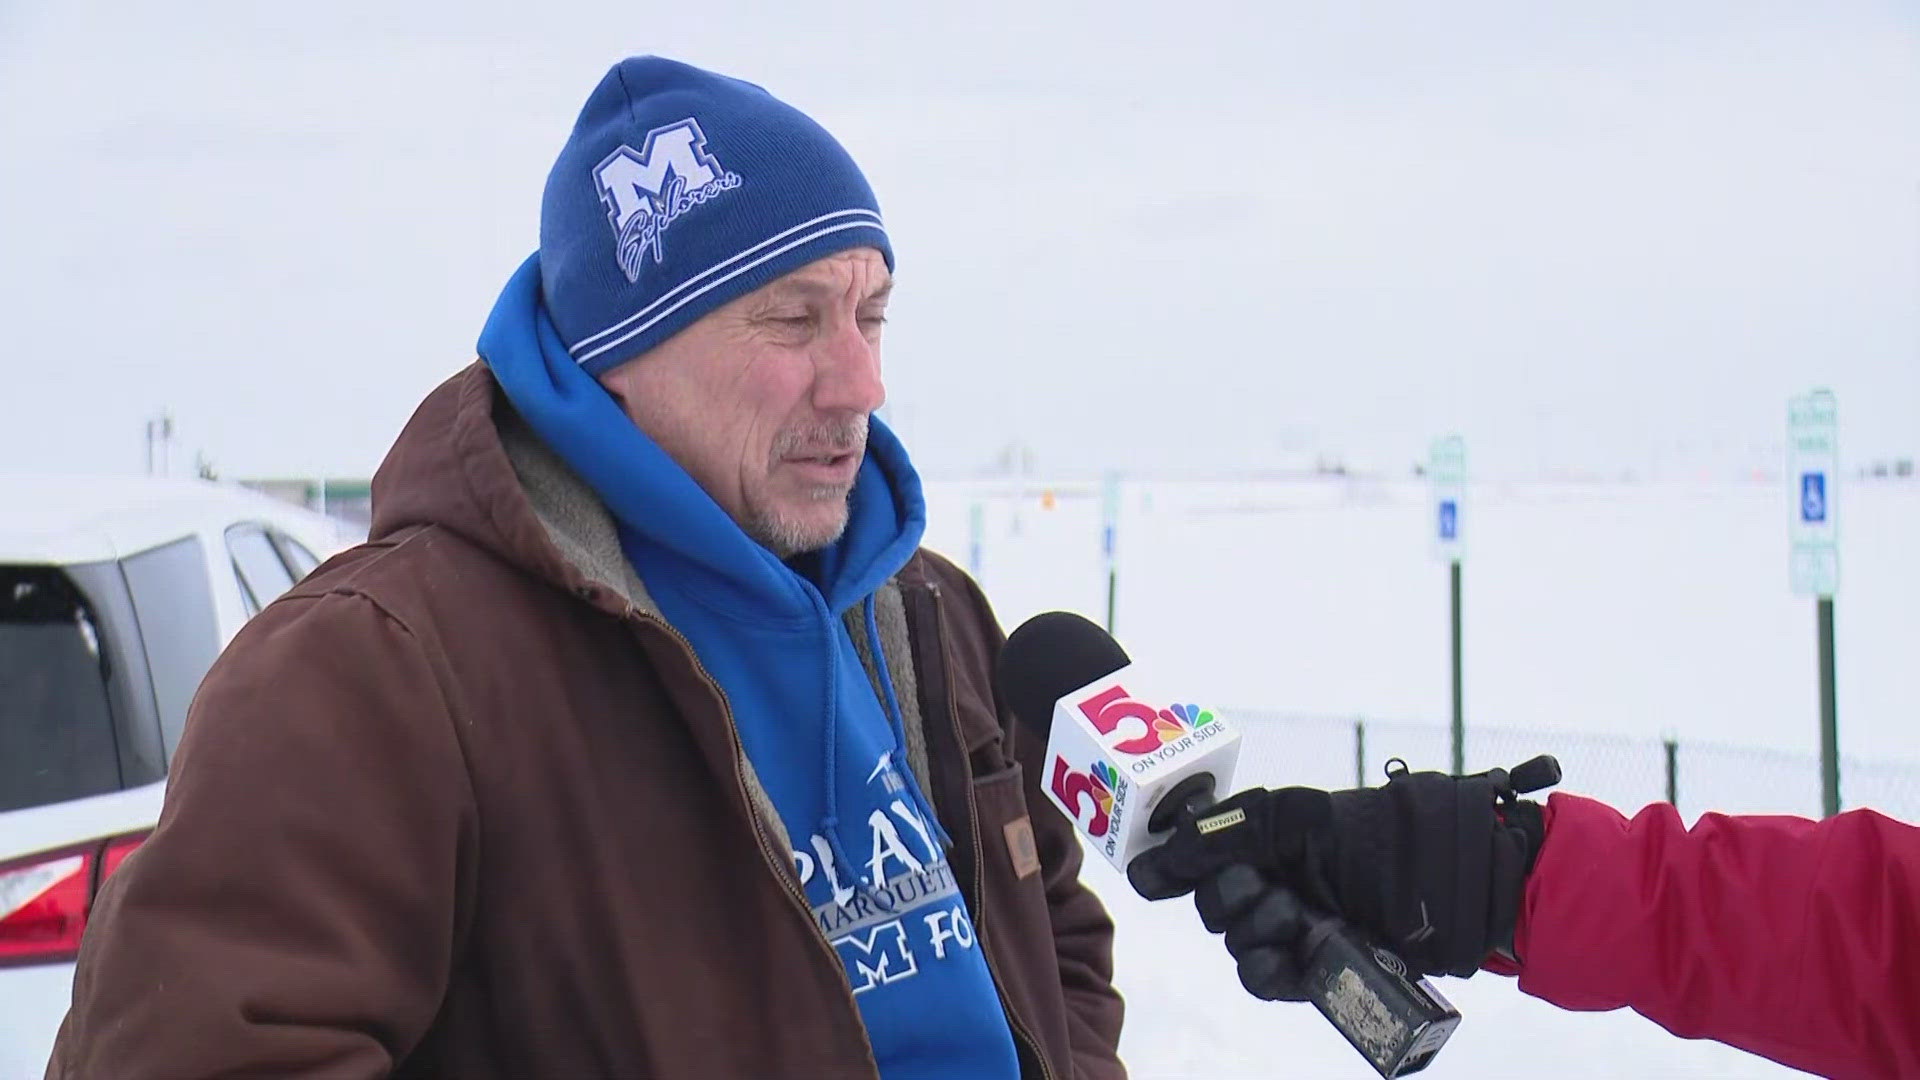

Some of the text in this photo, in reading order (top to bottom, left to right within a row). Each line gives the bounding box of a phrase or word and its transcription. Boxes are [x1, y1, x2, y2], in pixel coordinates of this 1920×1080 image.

[593, 118, 722, 238] M
[1077, 684, 1164, 755] 5
[1131, 721, 1225, 773] ON YOUR SIDE
[1051, 754, 1109, 838] 5
[1105, 775, 1129, 858] ON YOUR SIDE
